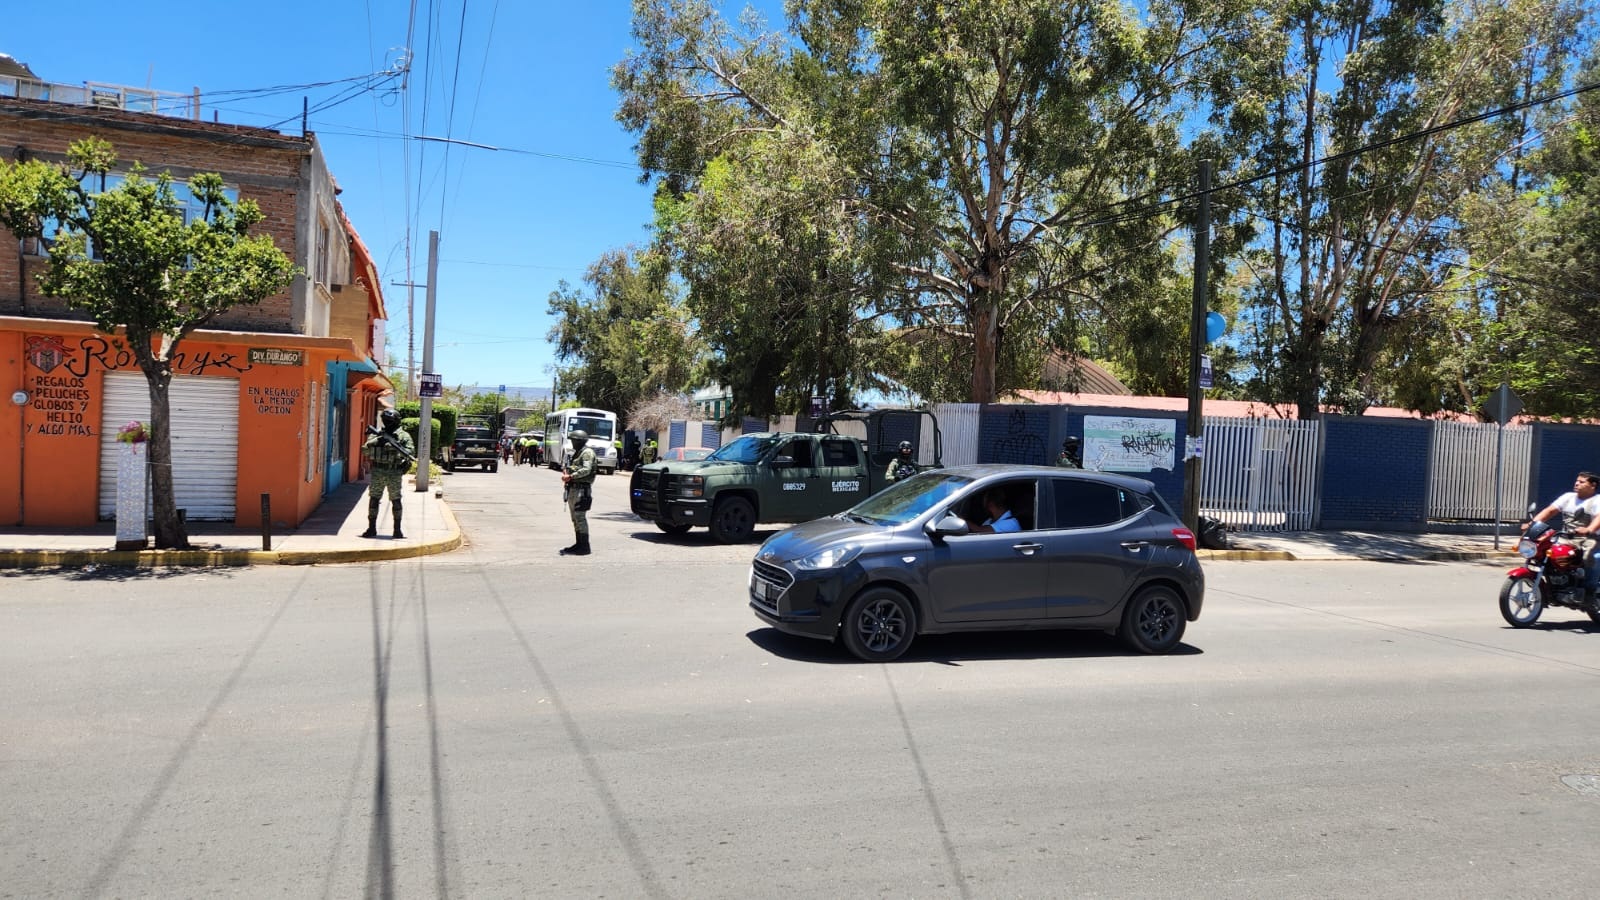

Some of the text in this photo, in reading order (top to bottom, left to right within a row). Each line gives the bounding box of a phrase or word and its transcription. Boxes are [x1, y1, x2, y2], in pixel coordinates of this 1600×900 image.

[266, 352, 298, 362] DURANGO
[36, 376, 85, 388] REGALOS
[35, 388, 90, 400] PELUCHES
[248, 386, 300, 397] EN REGALOS
[33, 399, 74, 410] GLOBOS
[254, 396, 296, 406] LA MEJOR
[47, 412, 83, 423] HELIO
[37, 424, 64, 435] ALGO
